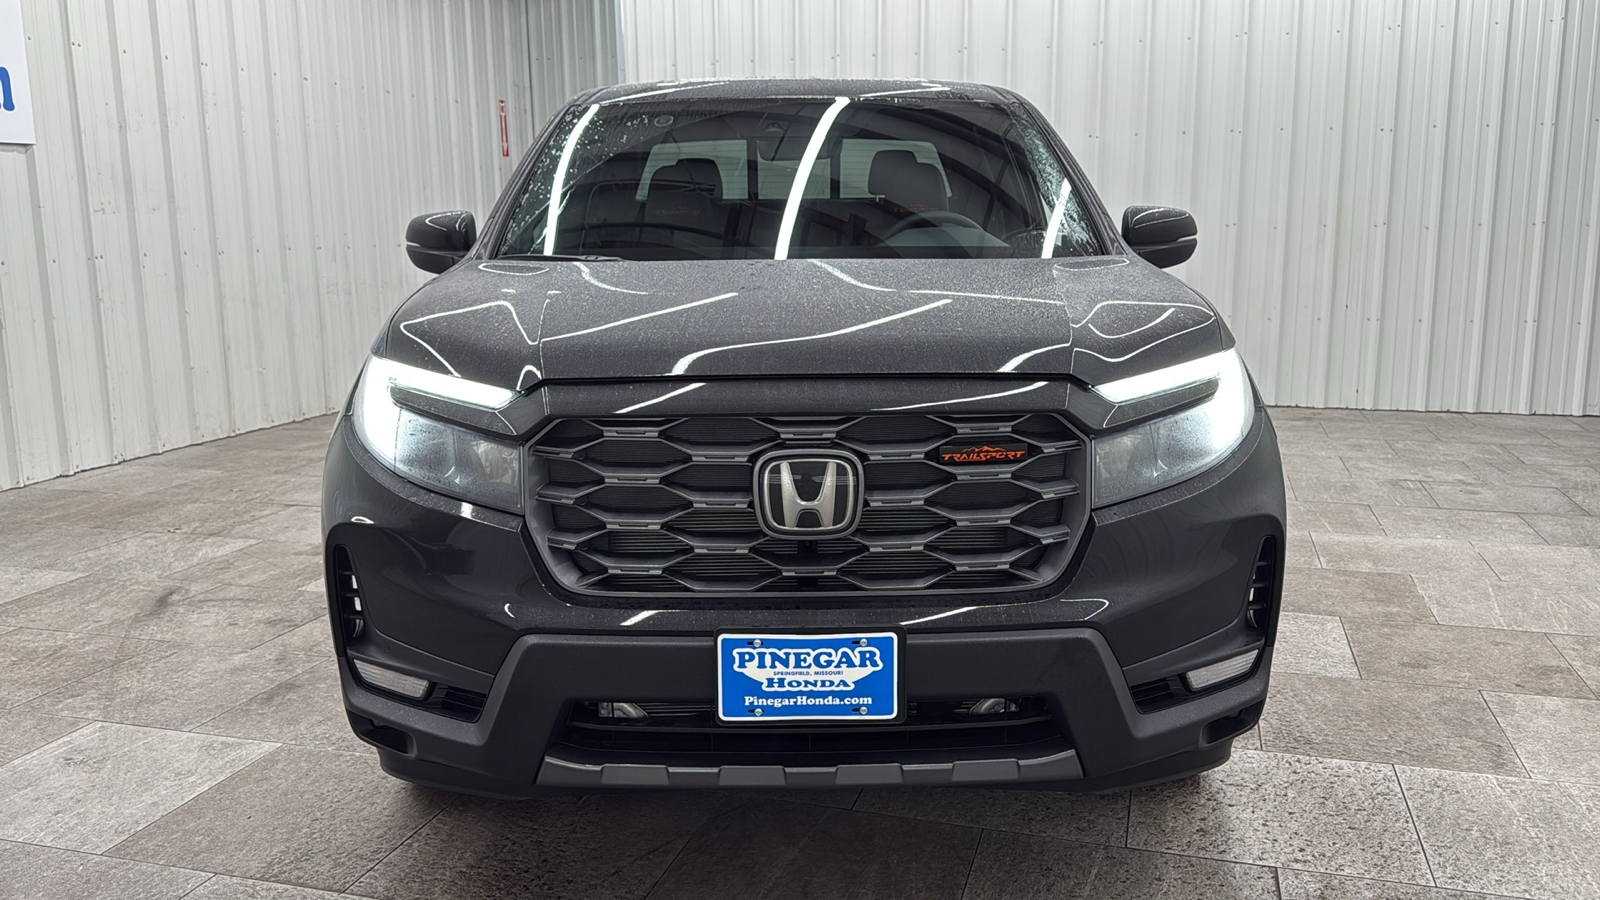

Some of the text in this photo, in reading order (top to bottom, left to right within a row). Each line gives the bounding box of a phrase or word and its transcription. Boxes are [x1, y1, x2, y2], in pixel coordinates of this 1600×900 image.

[941, 450, 1026, 462] TRAILSPORT
[735, 649, 880, 669] PINEGAR
[765, 677, 851, 688] HONDA
[744, 695, 872, 707] PinegarHonda.com
